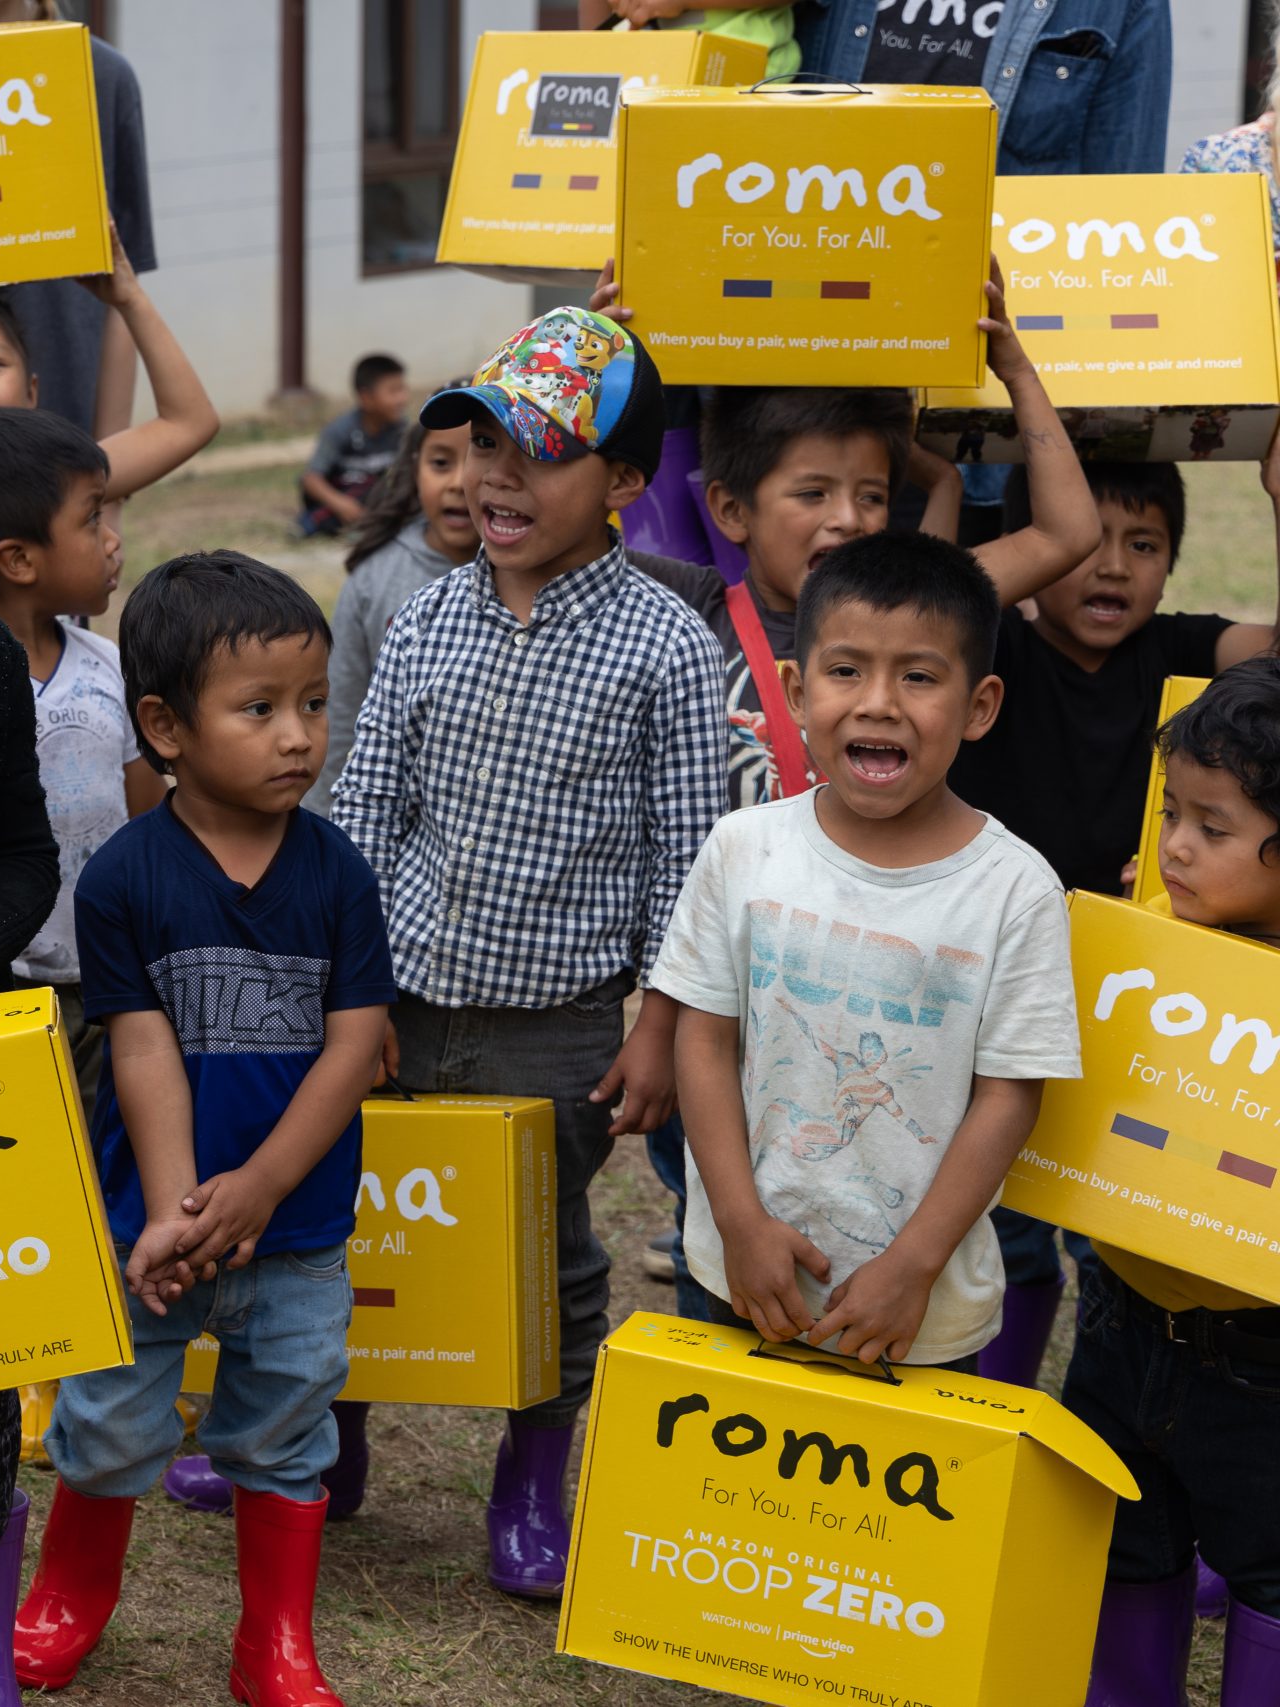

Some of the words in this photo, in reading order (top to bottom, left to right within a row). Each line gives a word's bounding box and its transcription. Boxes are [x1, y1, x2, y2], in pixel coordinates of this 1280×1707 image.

[880, 29, 912, 50] You.
[918, 34, 944, 53] For
[947, 38, 974, 59] All.
[18, 232, 41, 245] and
[722, 225, 755, 248] For
[763, 226, 807, 248] You.
[817, 227, 850, 249] For
[857, 226, 892, 249] All.
[1010, 271, 1042, 289] For
[1048, 270, 1093, 289] You.
[1101, 270, 1134, 288] For
[1140, 267, 1173, 288] All.
[649, 332, 687, 346] When
[690, 336, 716, 350] you
[718, 333, 744, 350] buy
[757, 334, 785, 351] pair,
[788, 337, 809, 348] we
[811, 335, 839, 351] give
[852, 335, 879, 352] pair
[881, 336, 907, 350] and
[910, 337, 950, 351] more!
[1107, 359, 1135, 374] give
[1148, 359, 1173, 373] pair
[1175, 358, 1201, 370] and
[1128, 1053, 1167, 1087] For
[1175, 1067, 1219, 1107] You.
[1231, 1088, 1271, 1123] For
[1018, 1147, 1058, 1175] When
[1060, 1162, 1089, 1186] you
[1090, 1170, 1119, 1197] buy
[1131, 1188, 1163, 1213] pair,
[1166, 1202, 1189, 1219] we
[1191, 1206, 1223, 1233] give
[1236, 1225, 1268, 1250] pair
[539, 1201, 550, 1233] The
[379, 1231, 412, 1255] All.
[540, 1236, 552, 1302] Poverty
[41, 1339, 74, 1357] ARE
[540, 1306, 553, 1363] Giving
[382, 1346, 407, 1361] pair
[409, 1347, 435, 1360] and
[437, 1349, 476, 1362] more!
[933, 1388, 1025, 1414] roma
[701, 1476, 739, 1506] For
[747, 1490, 796, 1522] You.
[809, 1502, 848, 1532] For
[854, 1513, 893, 1543] All.
[684, 1528, 774, 1558] AMAZON
[787, 1550, 895, 1587] ORIGINAL
[623, 1530, 793, 1600] TROOP
[802, 1574, 945, 1638] ZERO
[701, 1611, 741, 1630] WATCH
[742, 1620, 772, 1636] NOW
[782, 1628, 820, 1647] prime
[821, 1636, 855, 1655] video
[613, 1630, 659, 1653] SHOW
[662, 1641, 692, 1660] THE
[695, 1647, 769, 1680] UNIVERSE
[772, 1665, 811, 1688] WHO
[814, 1675, 847, 1696] YOU
[849, 1684, 900, 1707] TRULY
